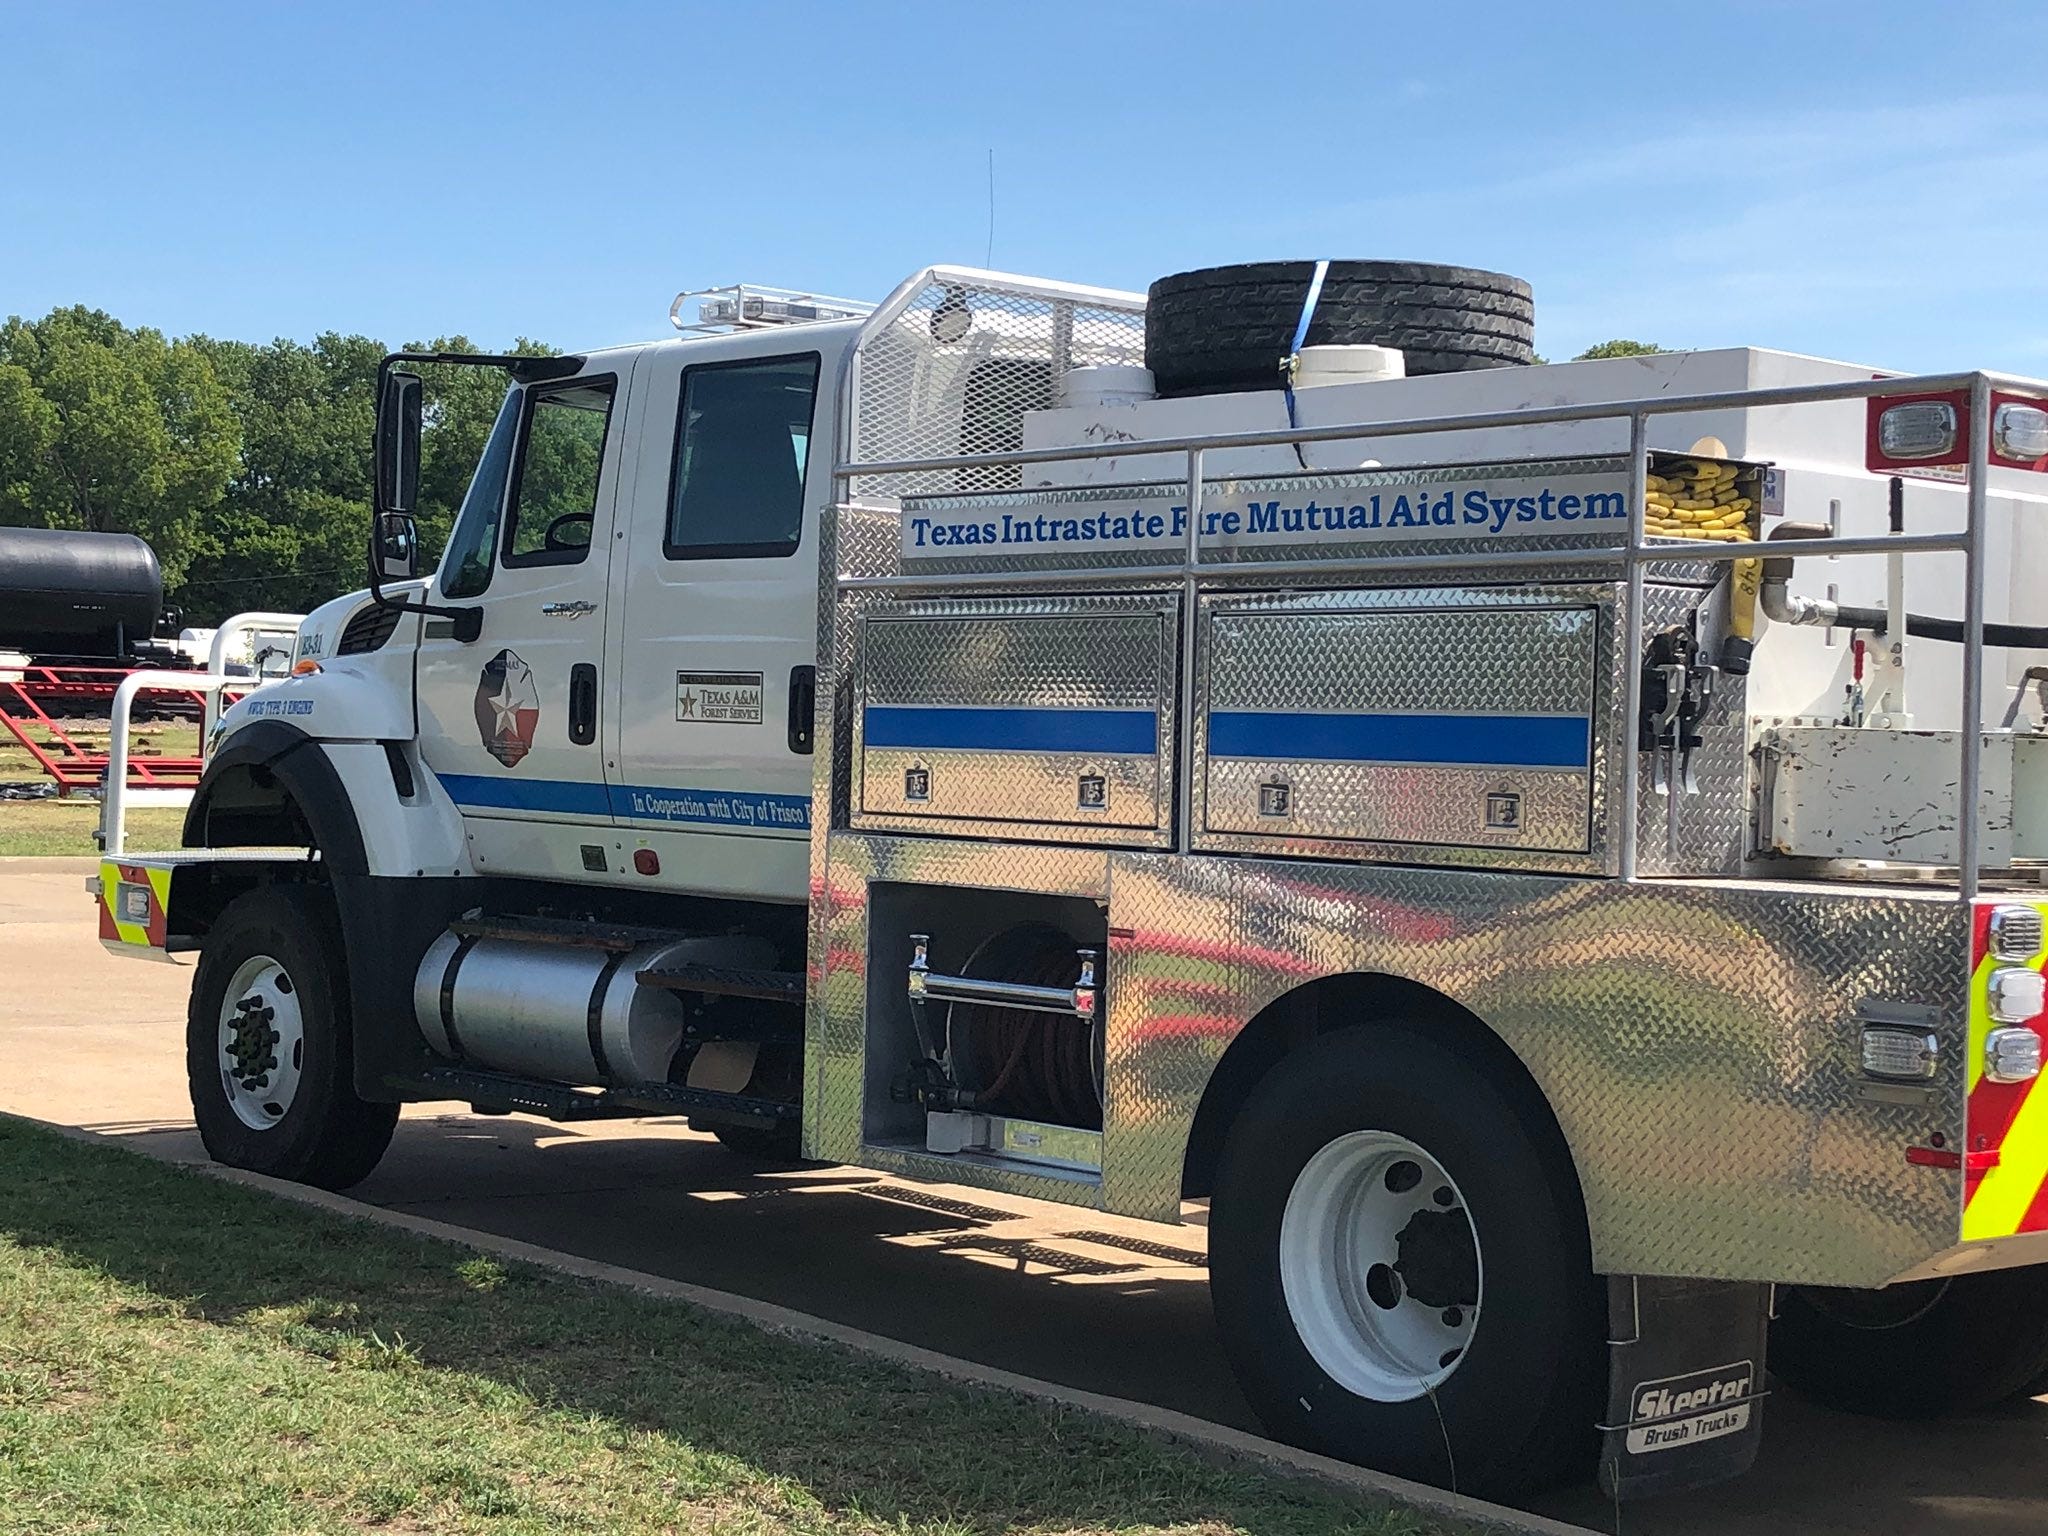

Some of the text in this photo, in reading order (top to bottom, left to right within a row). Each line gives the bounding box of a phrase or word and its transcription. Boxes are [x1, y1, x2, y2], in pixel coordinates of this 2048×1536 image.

[911, 488, 1628, 547] Texas Intrastate Fre Mutual Aid System
[699, 689, 760, 706] TEXAS A&M
[701, 706, 760, 720] FOREST SERVICE
[632, 793, 646, 812] In
[646, 794, 706, 819] Cooperation
[707, 797, 732, 819] with
[732, 798, 755, 825] City
[757, 800, 769, 820] of
[769, 801, 804, 823] Frisco
[1634, 1377, 1750, 1422] Skeeter
[1643, 1411, 1739, 1446] Brush Trucks
